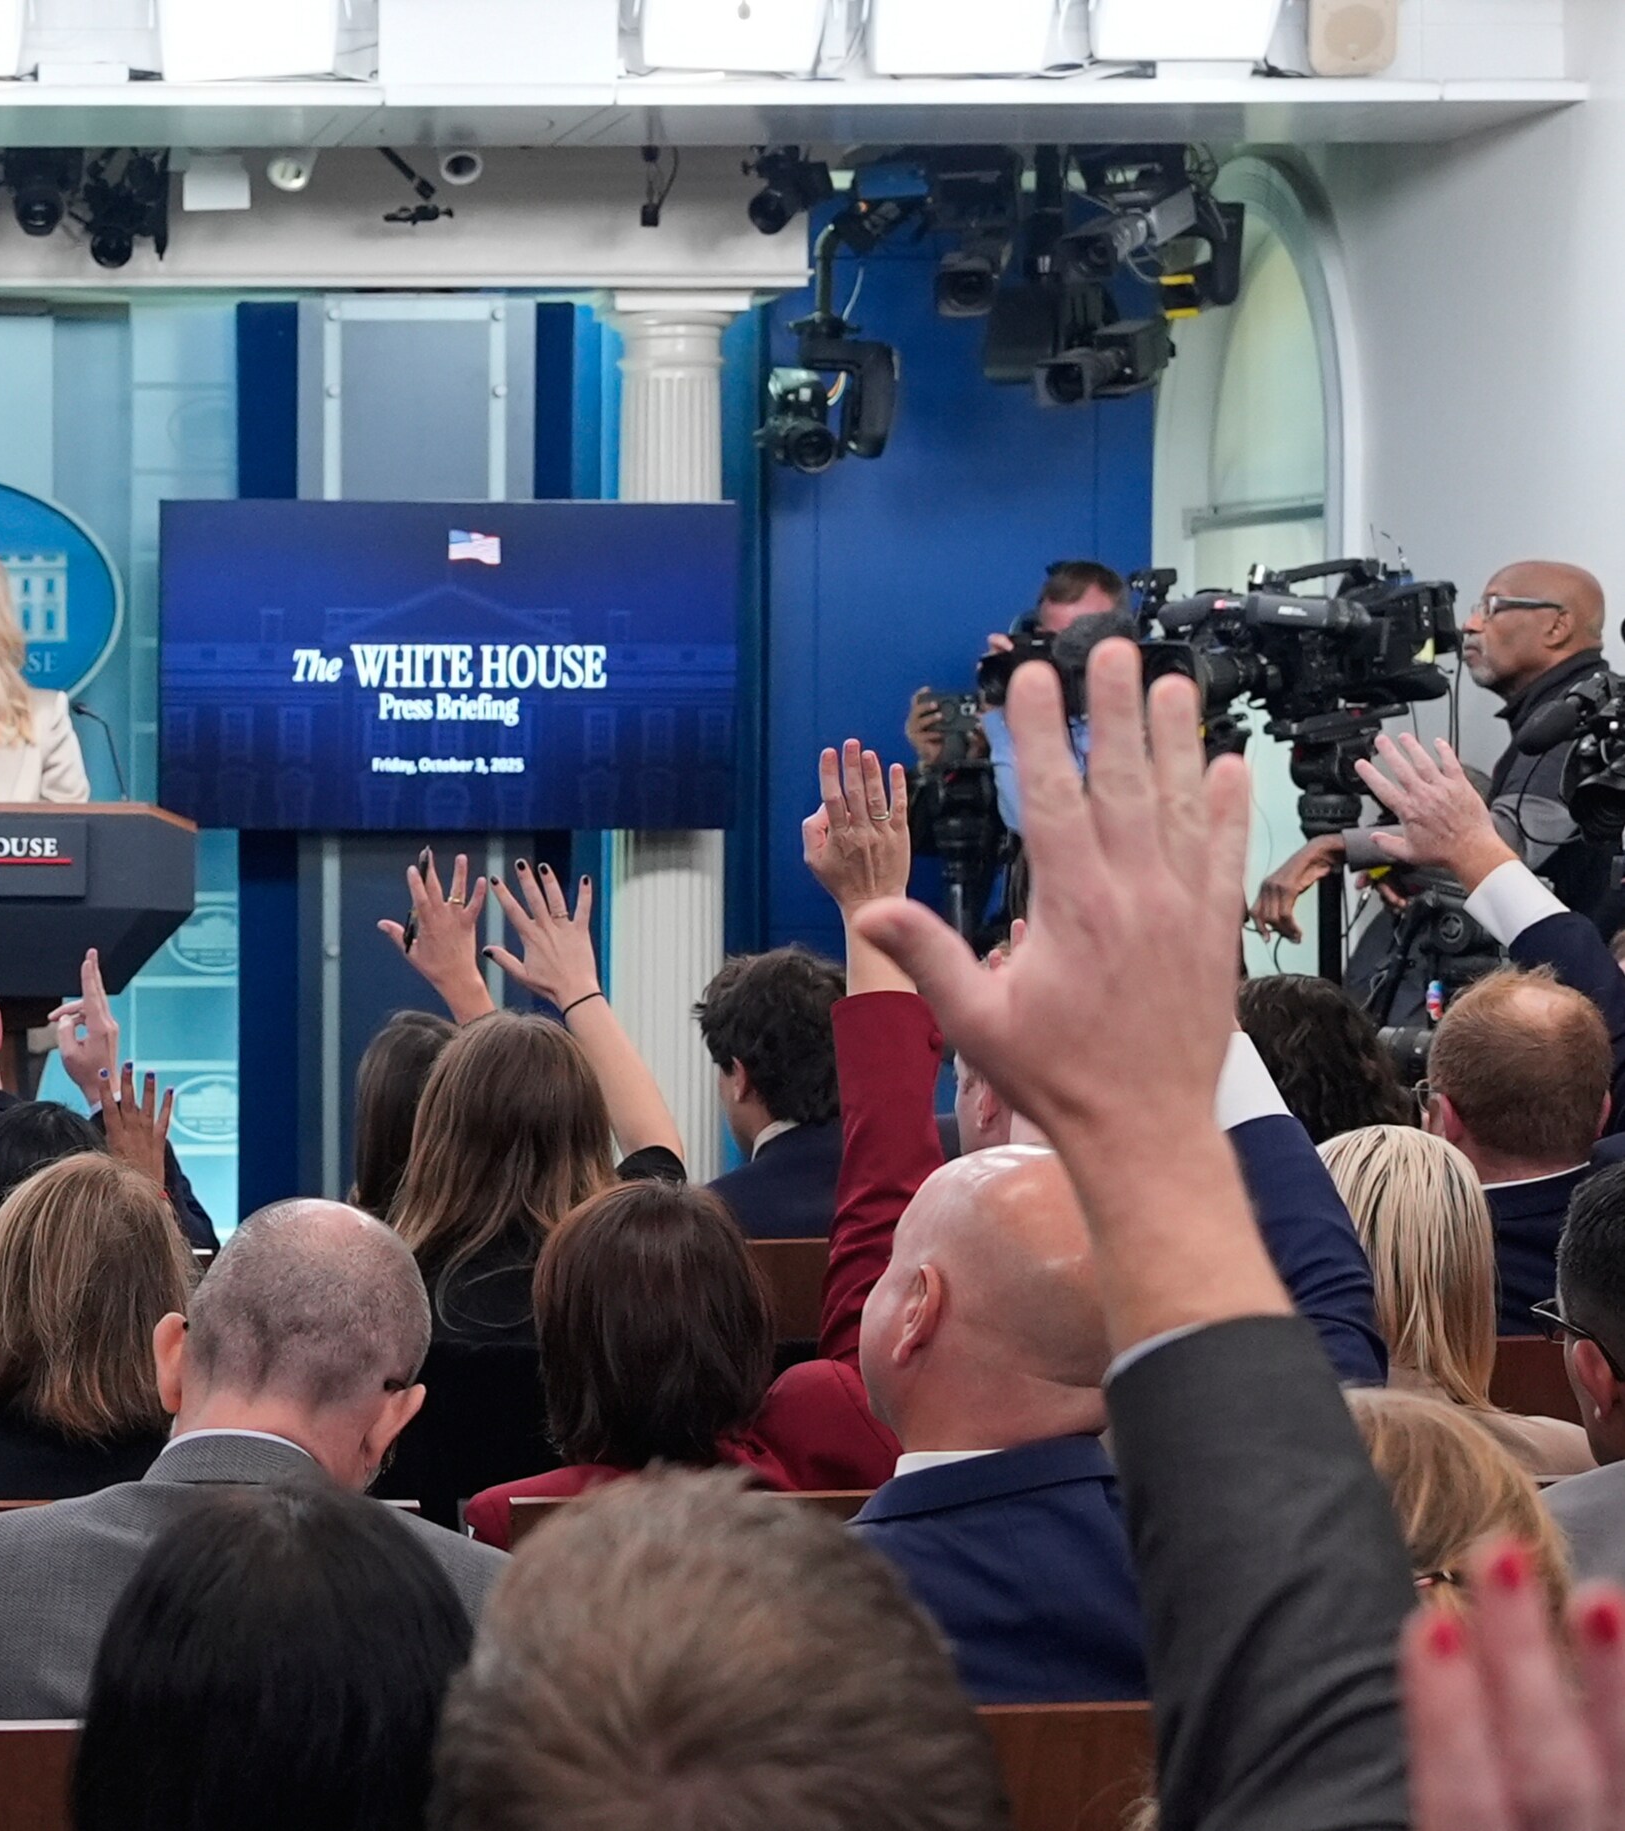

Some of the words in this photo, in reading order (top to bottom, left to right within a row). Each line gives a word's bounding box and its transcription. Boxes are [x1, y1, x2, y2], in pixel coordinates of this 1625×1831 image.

[292, 648, 344, 683] The
[349, 643, 474, 689] WHITE
[479, 644, 608, 689] HOUSE
[378, 693, 434, 721] Press
[436, 692, 520, 727] Briefing
[371, 756, 418, 776] Friday,
[418, 756, 474, 773] October
[475, 757, 489, 775] 3,
[490, 757, 525, 773] 2025
